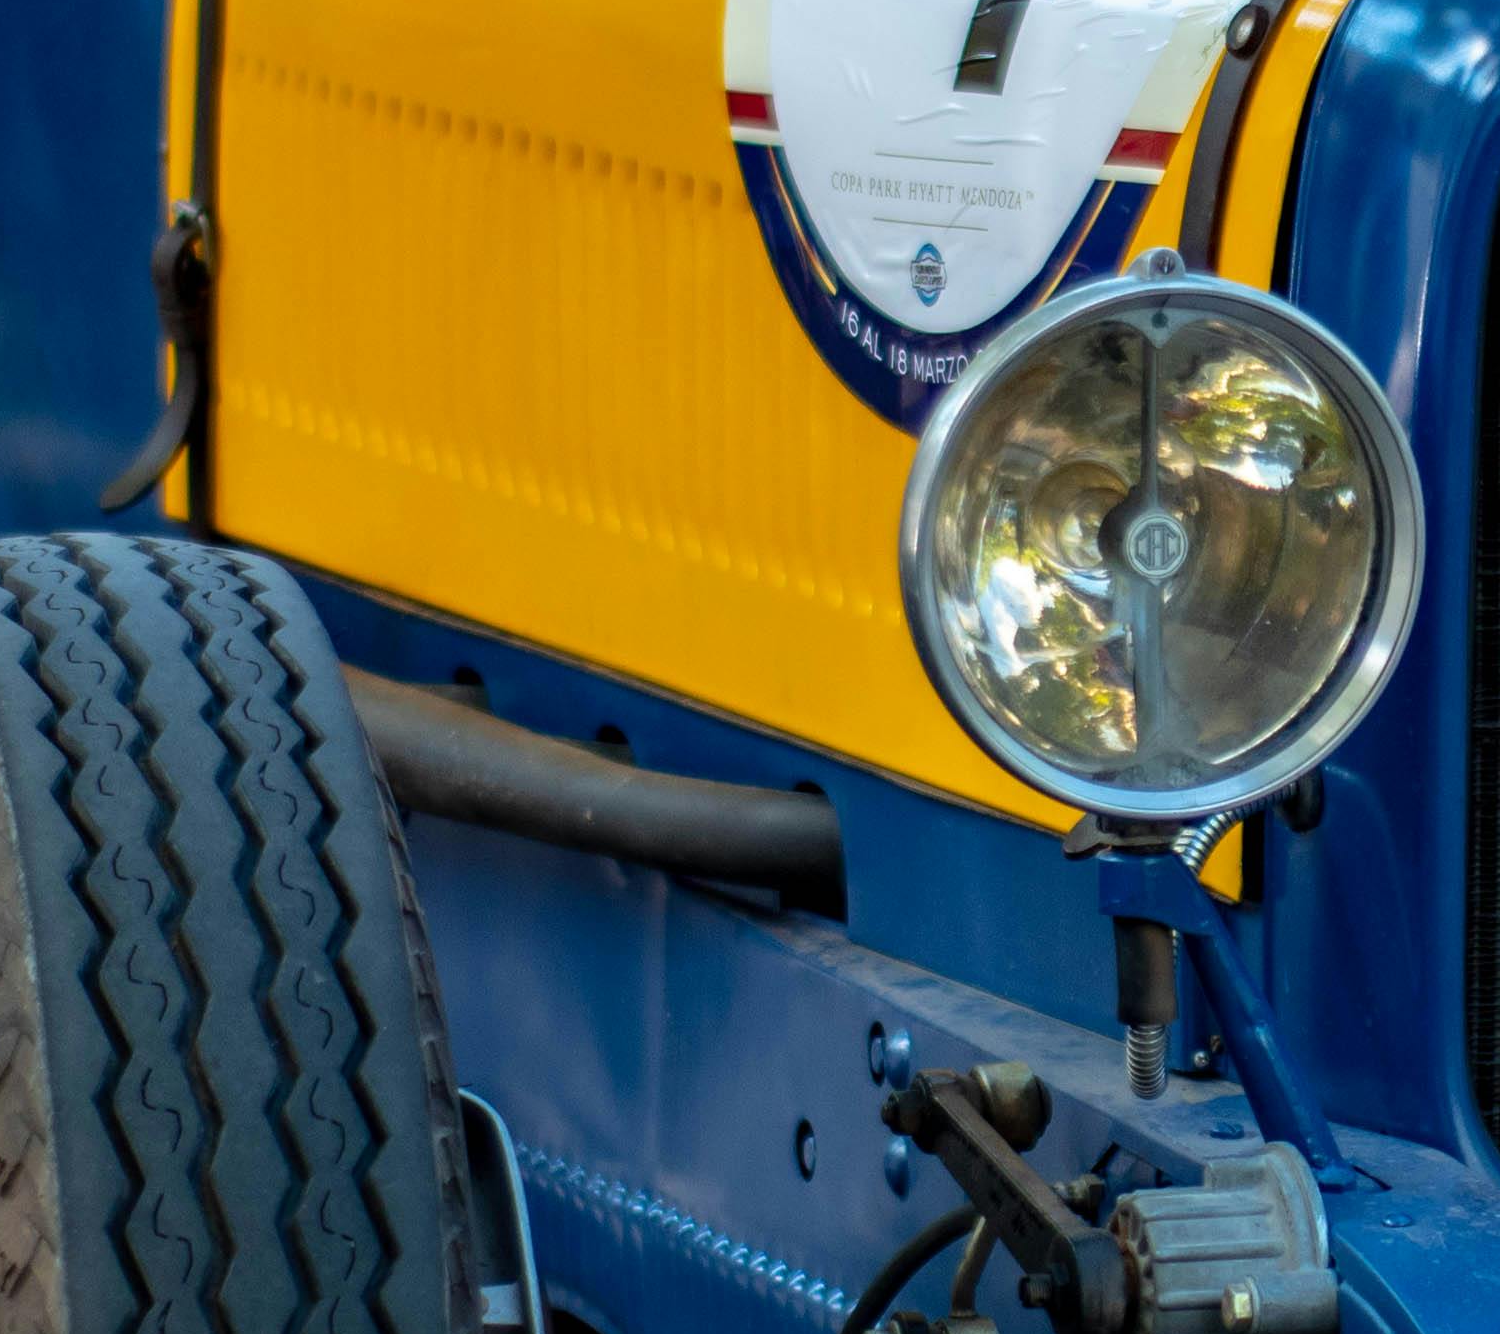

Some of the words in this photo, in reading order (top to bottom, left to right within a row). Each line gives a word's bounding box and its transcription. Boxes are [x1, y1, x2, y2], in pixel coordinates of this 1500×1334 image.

[830, 170, 864, 195] COPA
[868, 176, 902, 200] PARK
[907, 181, 955, 204] HYATT
[840, 301, 859, 338] 16
[862, 326, 883, 362] AL
[890, 344, 908, 376] 18
[913, 353, 969, 385] MARZO
